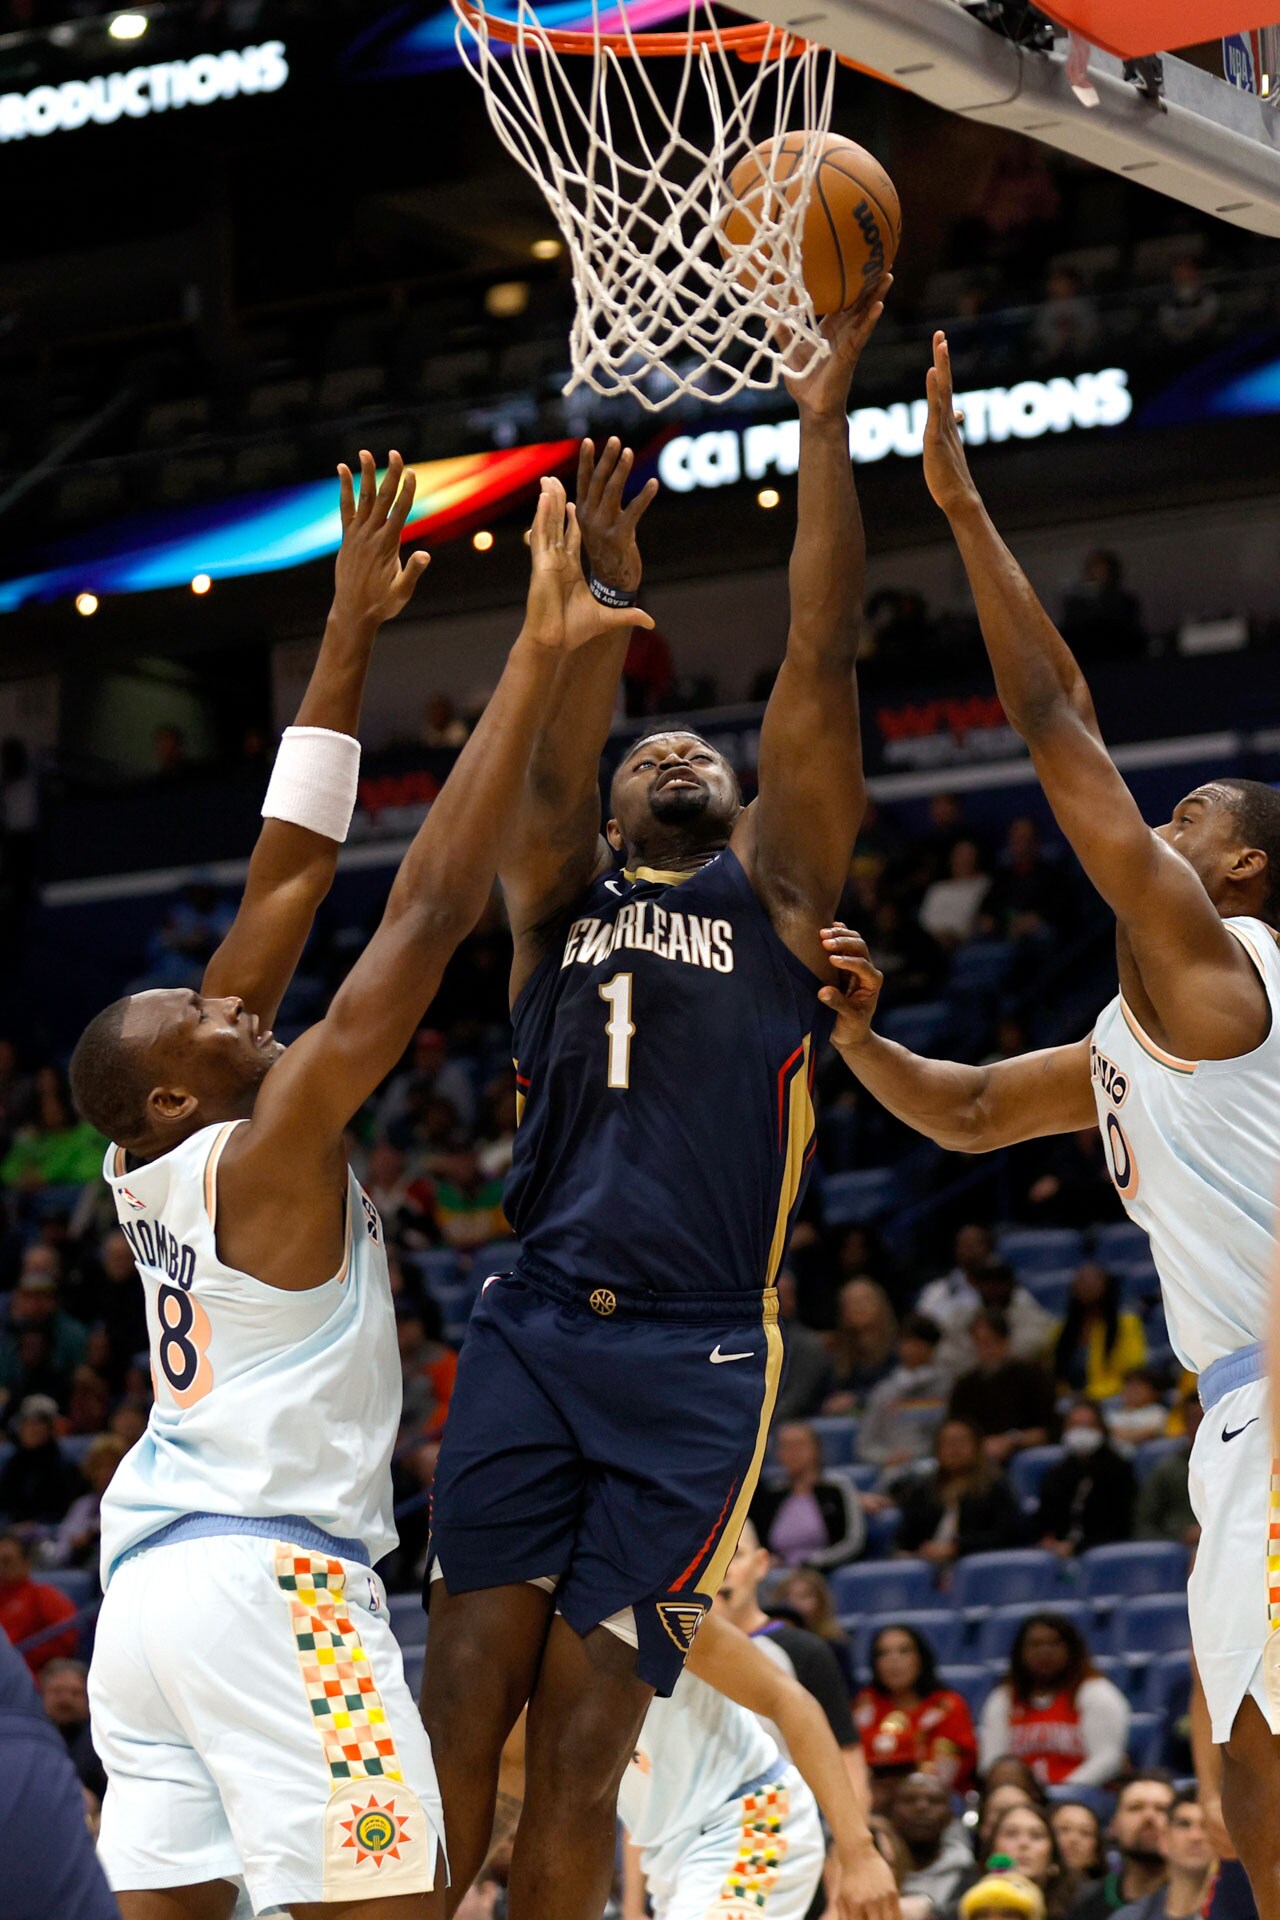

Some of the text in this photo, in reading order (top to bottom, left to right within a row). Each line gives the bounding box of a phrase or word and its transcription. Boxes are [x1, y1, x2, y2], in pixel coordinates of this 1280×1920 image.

[1228, 45, 1249, 83] NBA
[743, 367, 1133, 480] PRDUTIONS
[560, 901, 734, 974] EW RLEANS
[599, 972, 637, 1089] 1
[157, 1283, 202, 1396] 8
